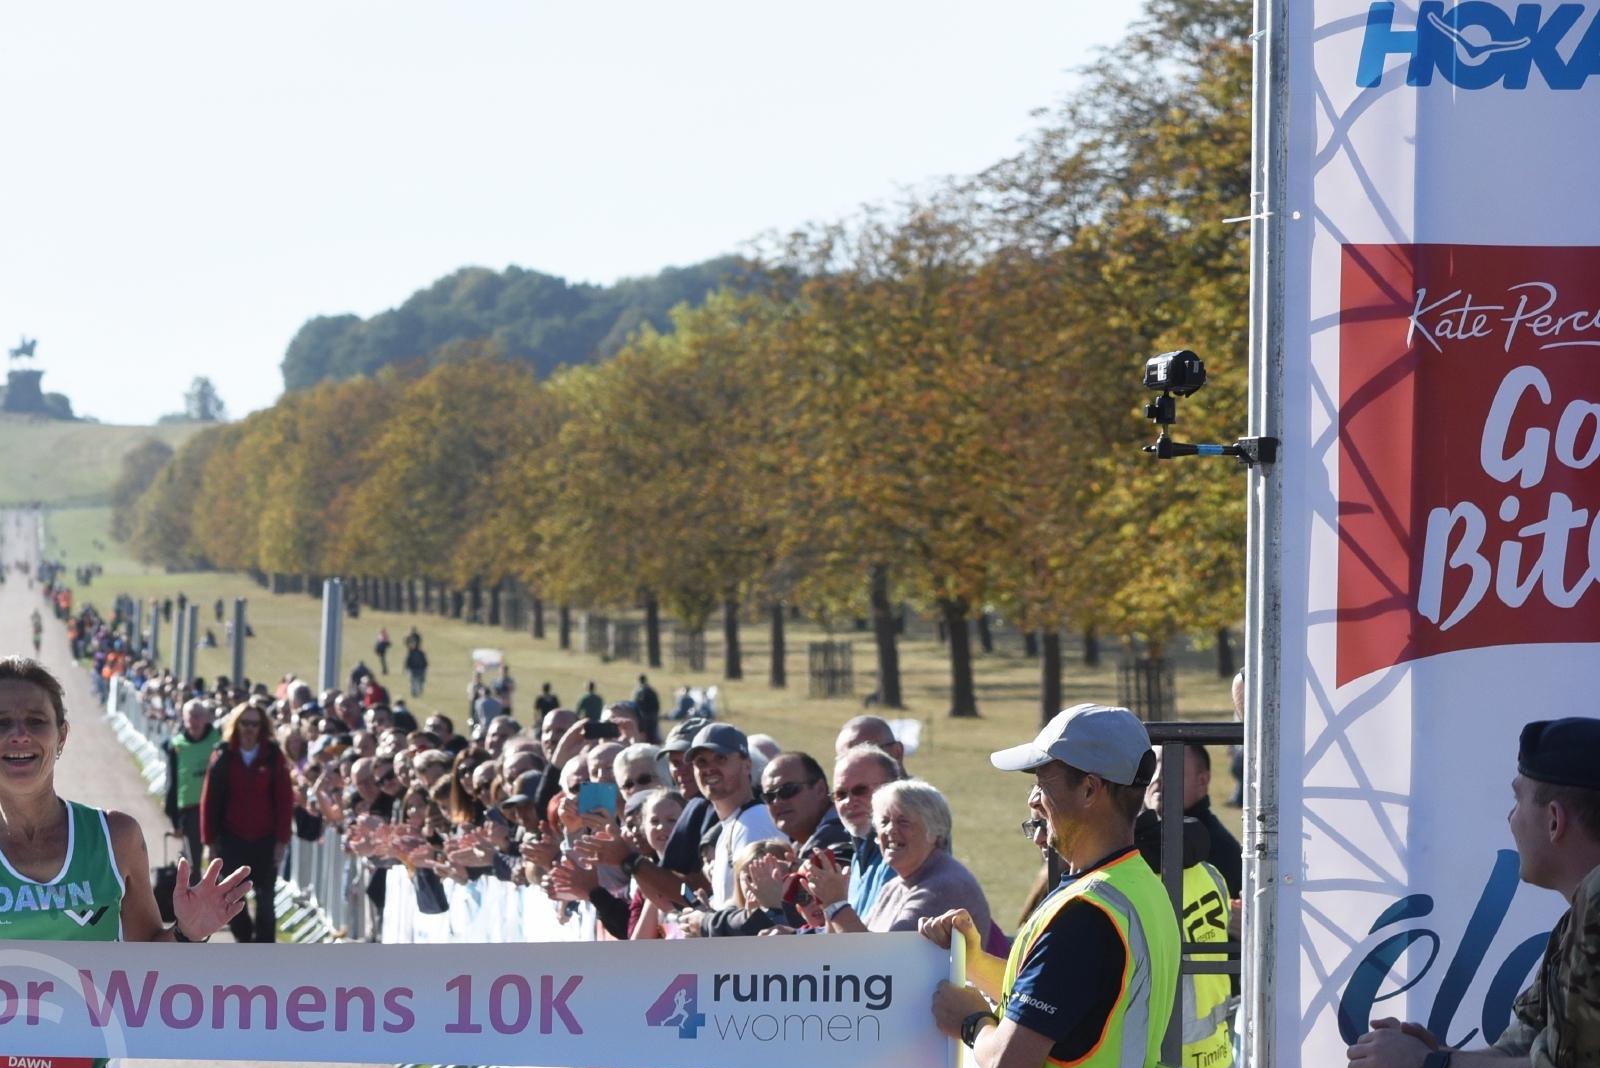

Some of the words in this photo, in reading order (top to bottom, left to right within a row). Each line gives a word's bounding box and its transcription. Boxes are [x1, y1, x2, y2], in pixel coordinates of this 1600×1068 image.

[1406, 288, 1505, 353] Kate
[79, 969, 414, 1033] Womens
[444, 973, 584, 1036] 10K
[712, 964, 894, 1011] running
[1019, 993, 1058, 1015] BROOKS
[714, 1013, 882, 1042] women
